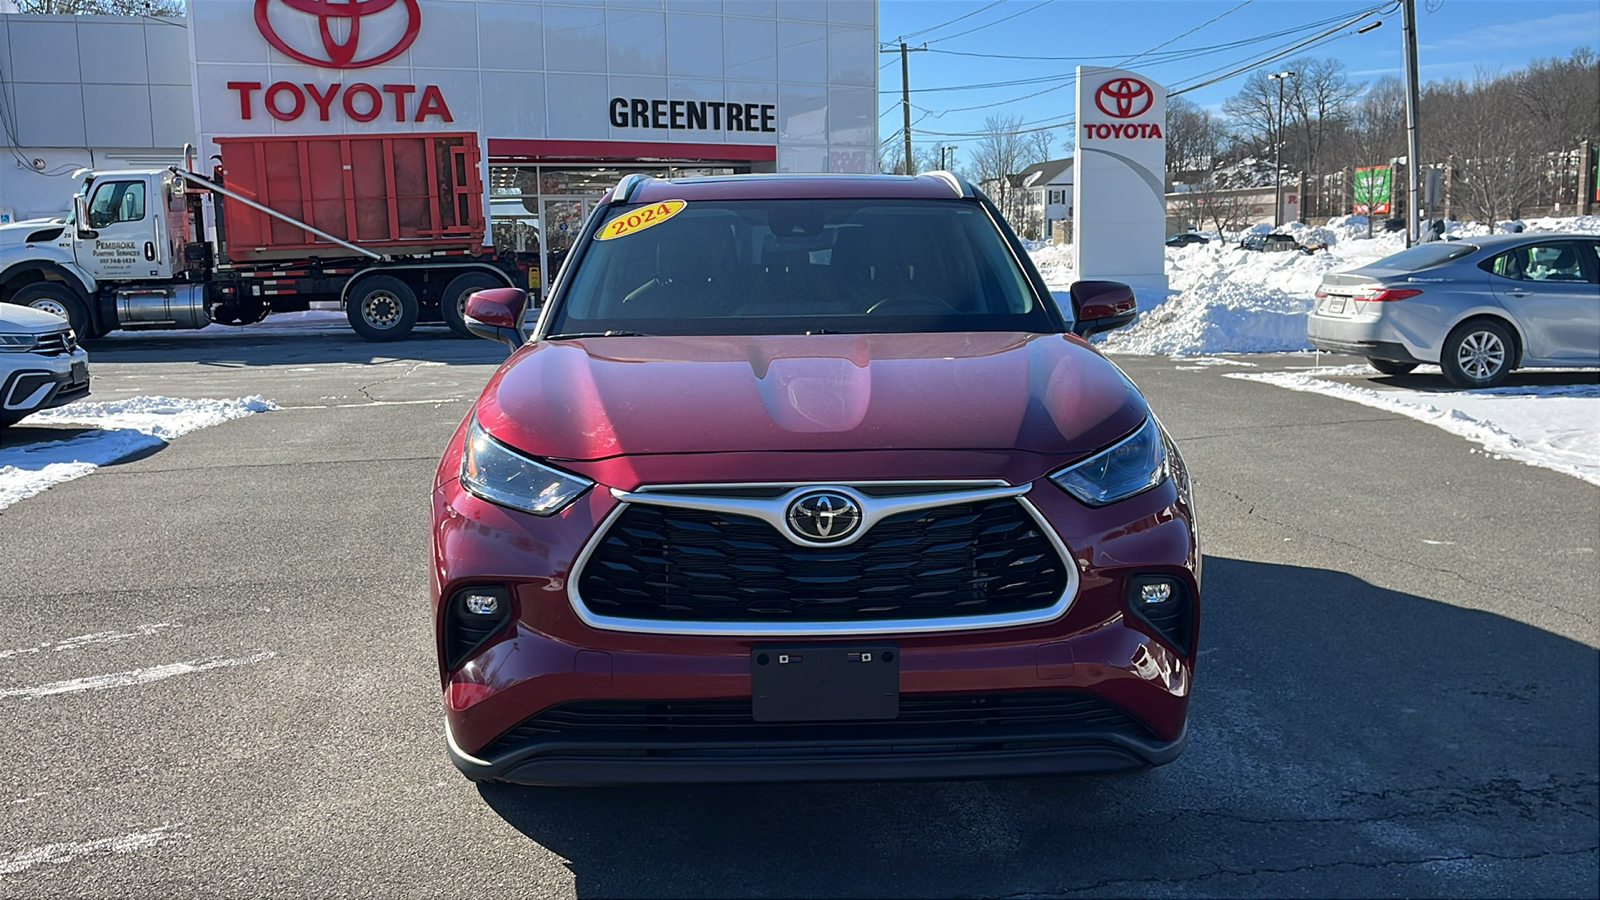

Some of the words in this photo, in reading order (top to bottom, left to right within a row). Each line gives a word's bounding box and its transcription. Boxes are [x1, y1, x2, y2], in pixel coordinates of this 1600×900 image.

[227, 81, 454, 122] TOYOTA
[609, 97, 776, 133] GREENTREE
[1083, 123, 1163, 139] TOYOTA
[612, 203, 671, 235] 2024
[96, 240, 136, 249] PEMBROKE
